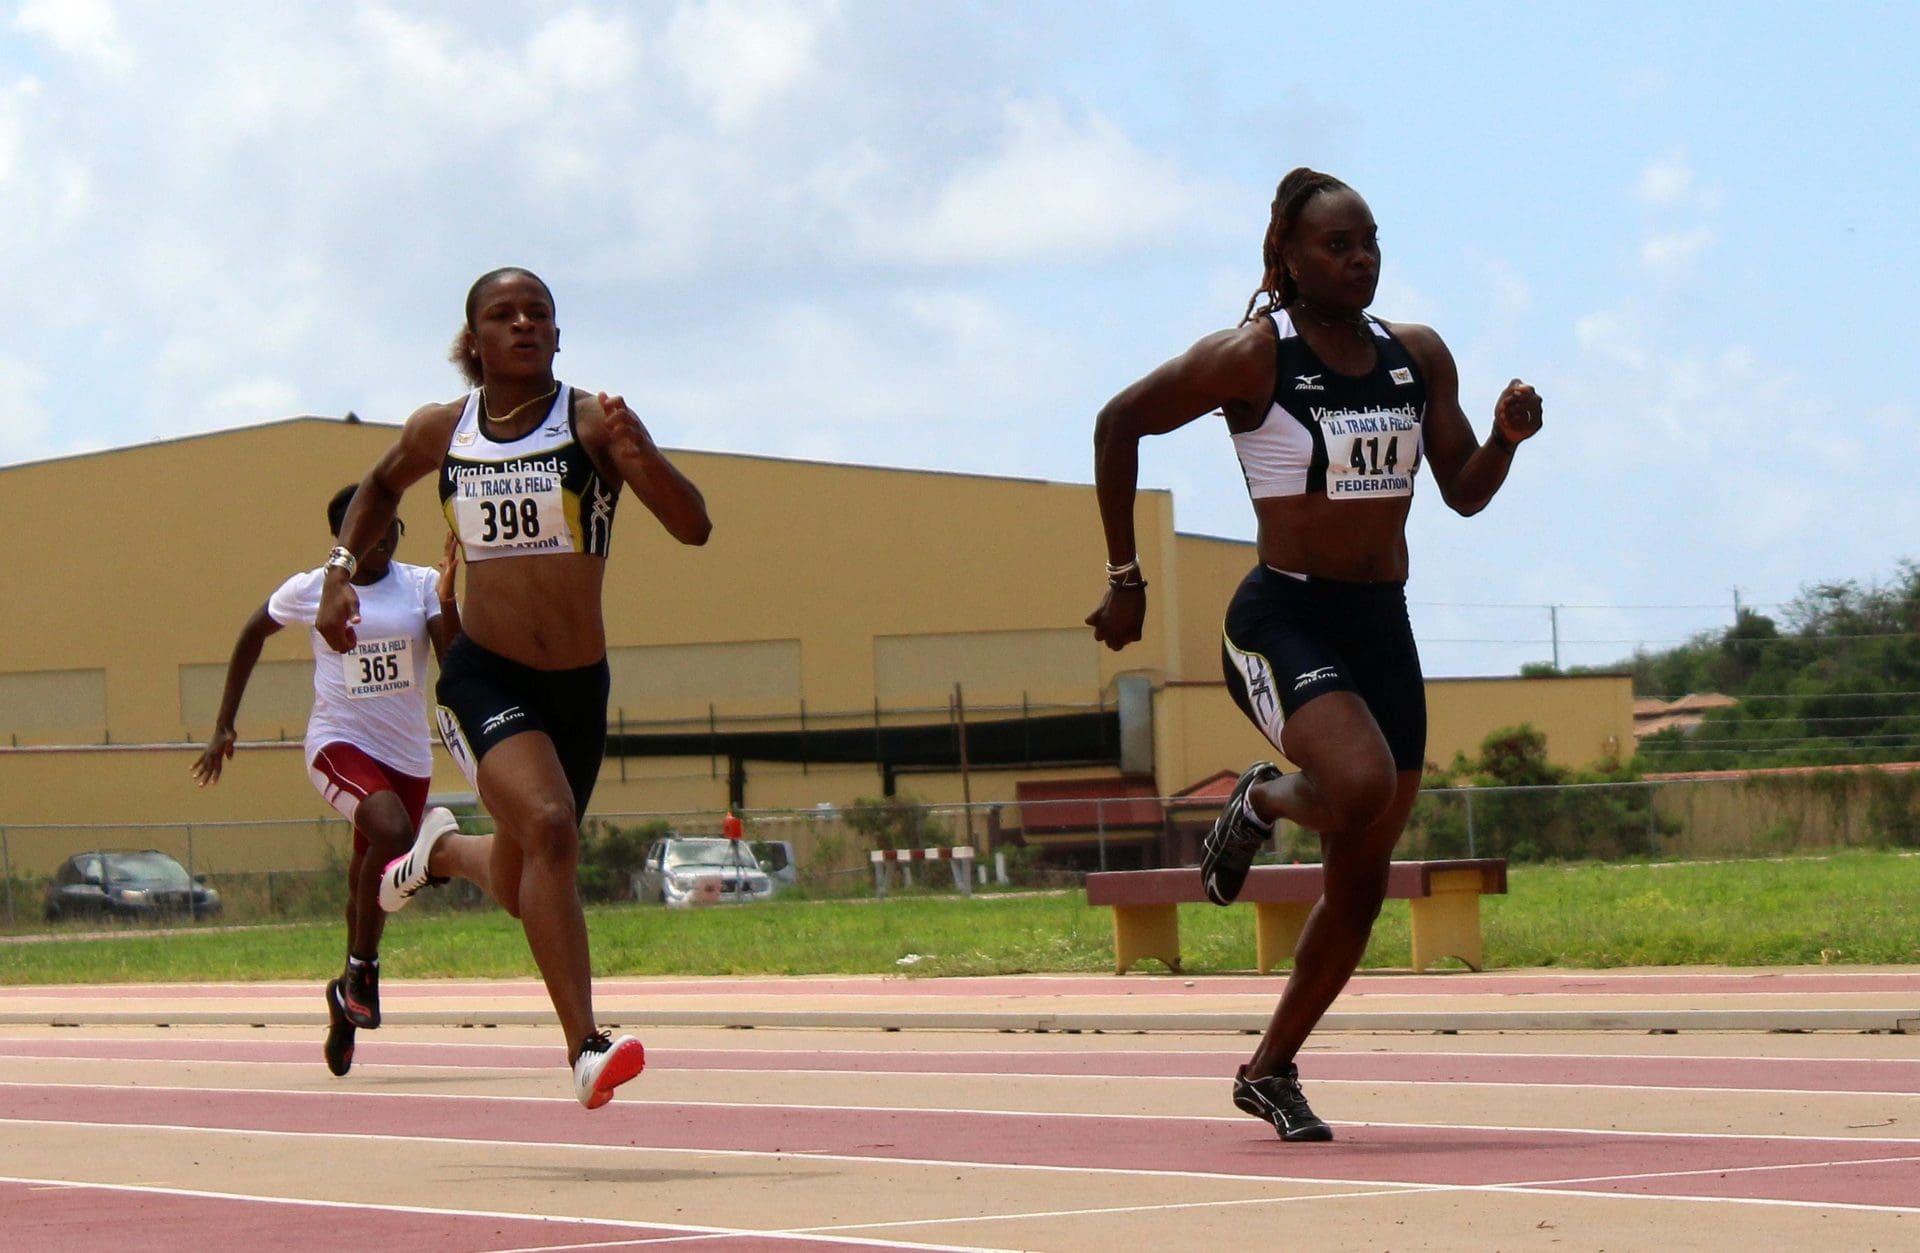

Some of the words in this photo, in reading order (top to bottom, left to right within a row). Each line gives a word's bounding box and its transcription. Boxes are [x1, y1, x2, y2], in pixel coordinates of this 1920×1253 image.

[1364, 402, 1416, 418] Islnds
[1328, 420, 1345, 436] V.I.
[1346, 418, 1378, 433] TRACK
[1380, 416, 1388, 431] &
[1389, 416, 1413, 432] FIELD
[503, 456, 568, 473] Islands
[1350, 436, 1398, 476] 414
[464, 481, 478, 498] V.I.
[481, 478, 512, 497] TRACK
[514, 479, 522, 494] &
[525, 476, 552, 493] FIELD
[1336, 478, 1408, 492] FEDERATION
[480, 497, 540, 542] 398
[358, 642, 381, 656] TRACK
[382, 641, 388, 653] &
[388, 640, 407, 652] FIELD
[359, 654, 398, 684] 365
[351, 680, 410, 695] FEDERATION
